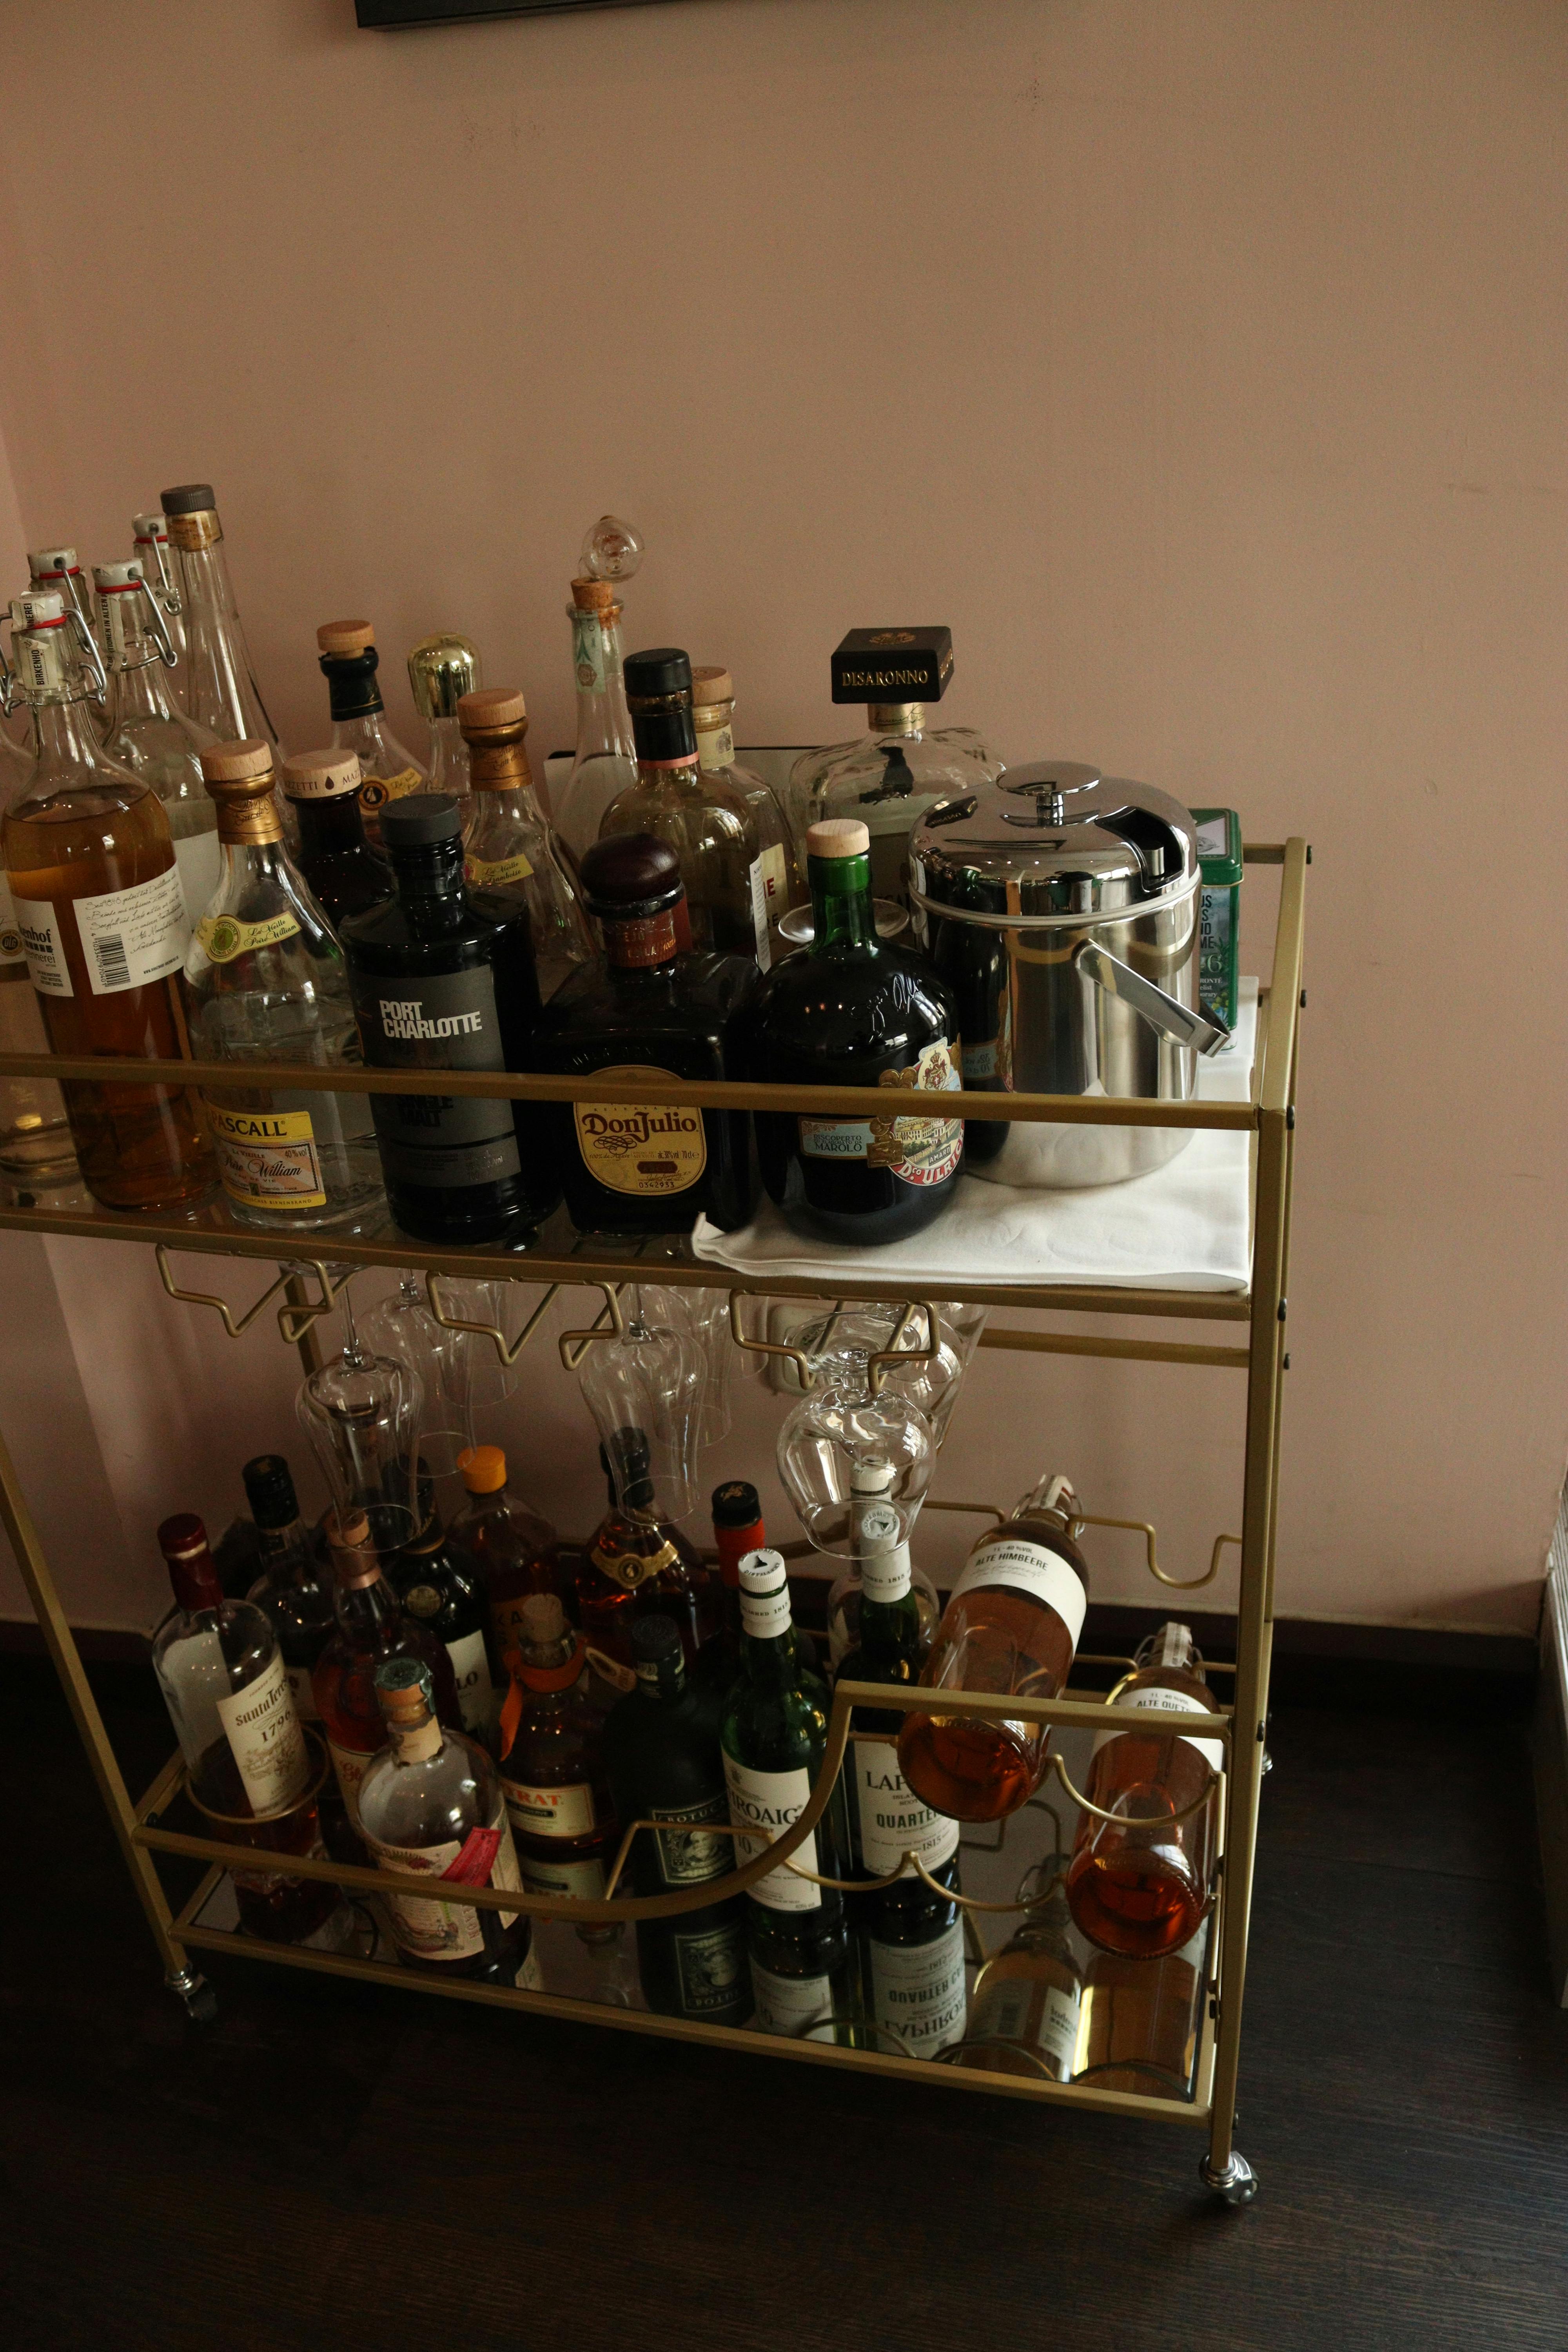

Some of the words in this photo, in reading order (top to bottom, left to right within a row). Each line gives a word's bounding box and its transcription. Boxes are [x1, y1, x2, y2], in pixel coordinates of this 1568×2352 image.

[842, 670, 928, 686] DISARONNO
[266, 924, 297, 940] William
[379, 1000, 423, 1020] PORT
[383, 1011, 483, 1039] CHARLOTTE
[815, 1142, 862, 1152] MAROLO
[929, 1146, 950, 1163] AMARO
[247, 1158, 302, 1177] William
[975, 1554, 996, 1567] ALTE
[998, 1553, 1048, 1571] HIMBEERE
